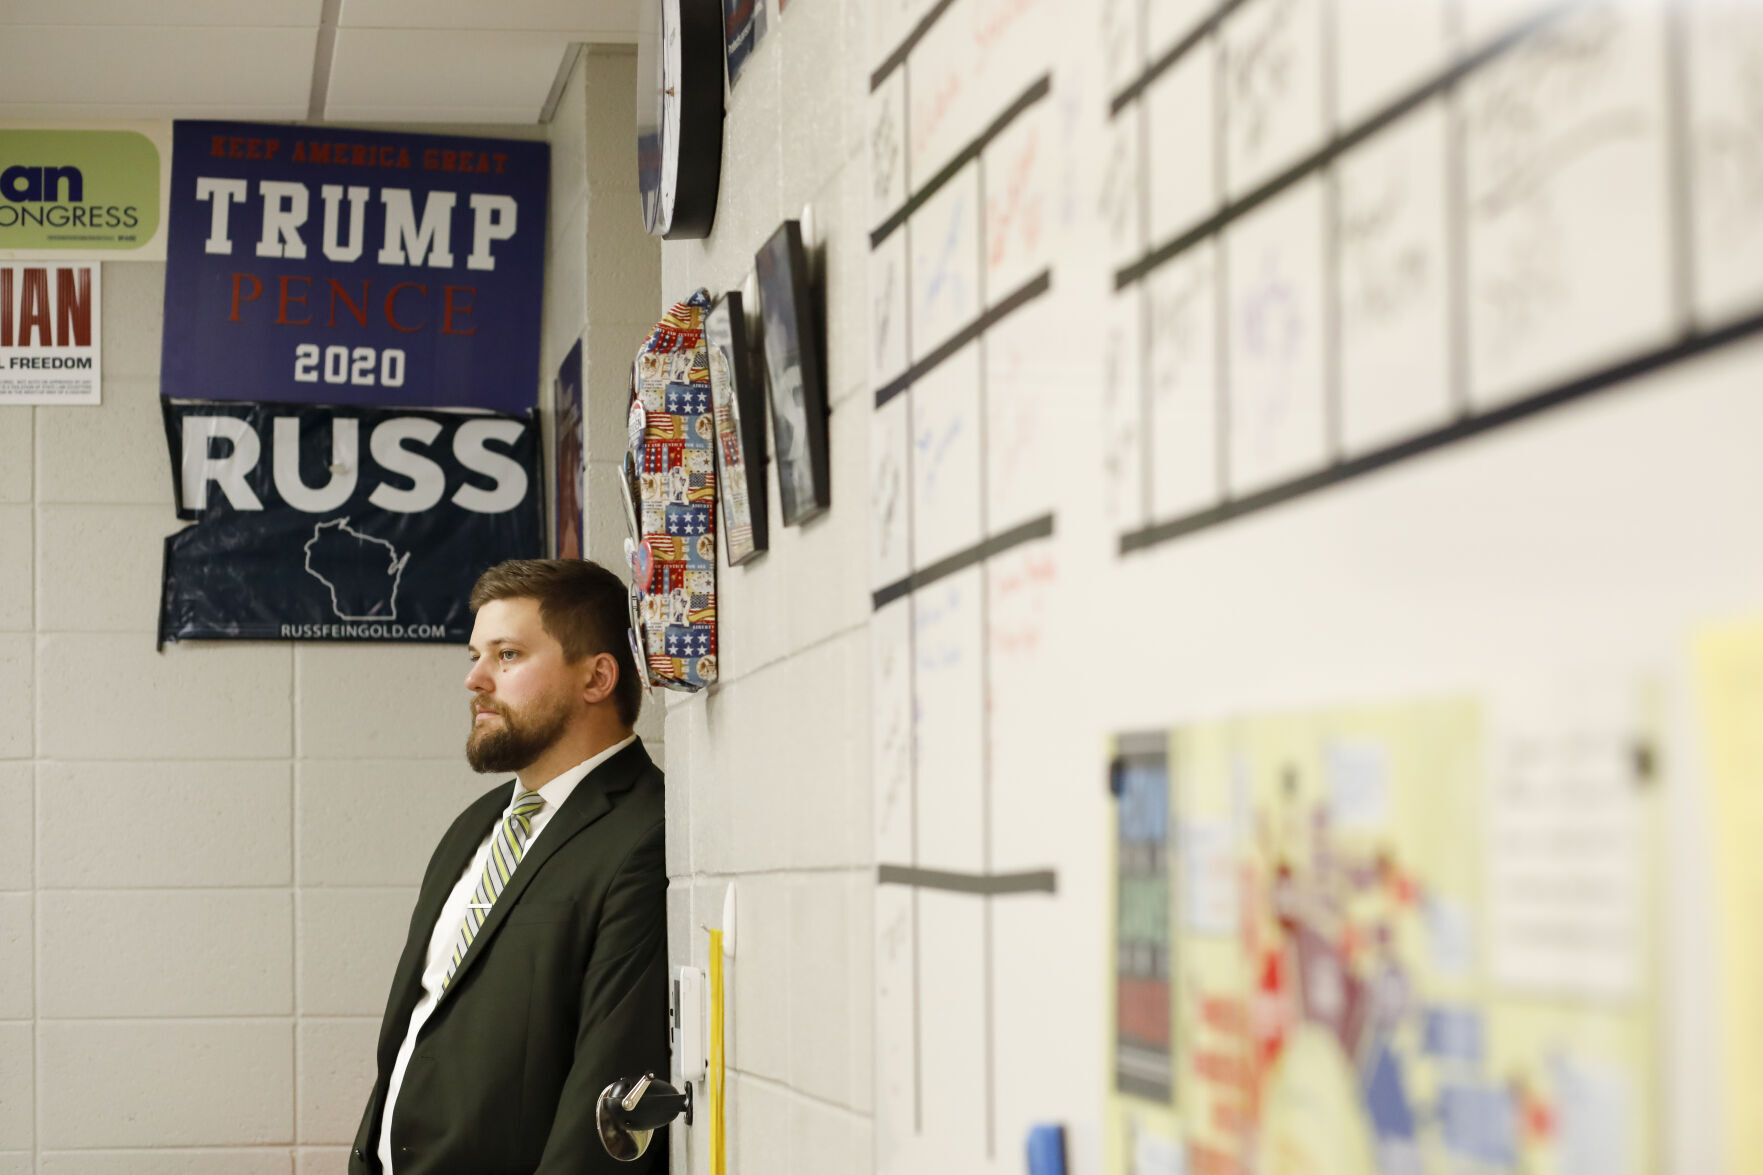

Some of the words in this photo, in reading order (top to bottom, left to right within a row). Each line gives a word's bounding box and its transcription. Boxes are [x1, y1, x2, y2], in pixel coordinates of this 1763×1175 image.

[210, 136, 280, 159] KEEP
[292, 141, 411, 168] AMERICA
[423, 149, 508, 174] GREAT
[0, 165, 83, 203] an
[196, 177, 518, 271] TRUMP
[227, 273, 479, 336] PENCE
[10, 357, 92, 369] FREEDOM
[294, 343, 406, 388] 2020
[182, 415, 529, 514] RUSS
[281, 624, 446, 638] RUSSFEINGOLD.COM
